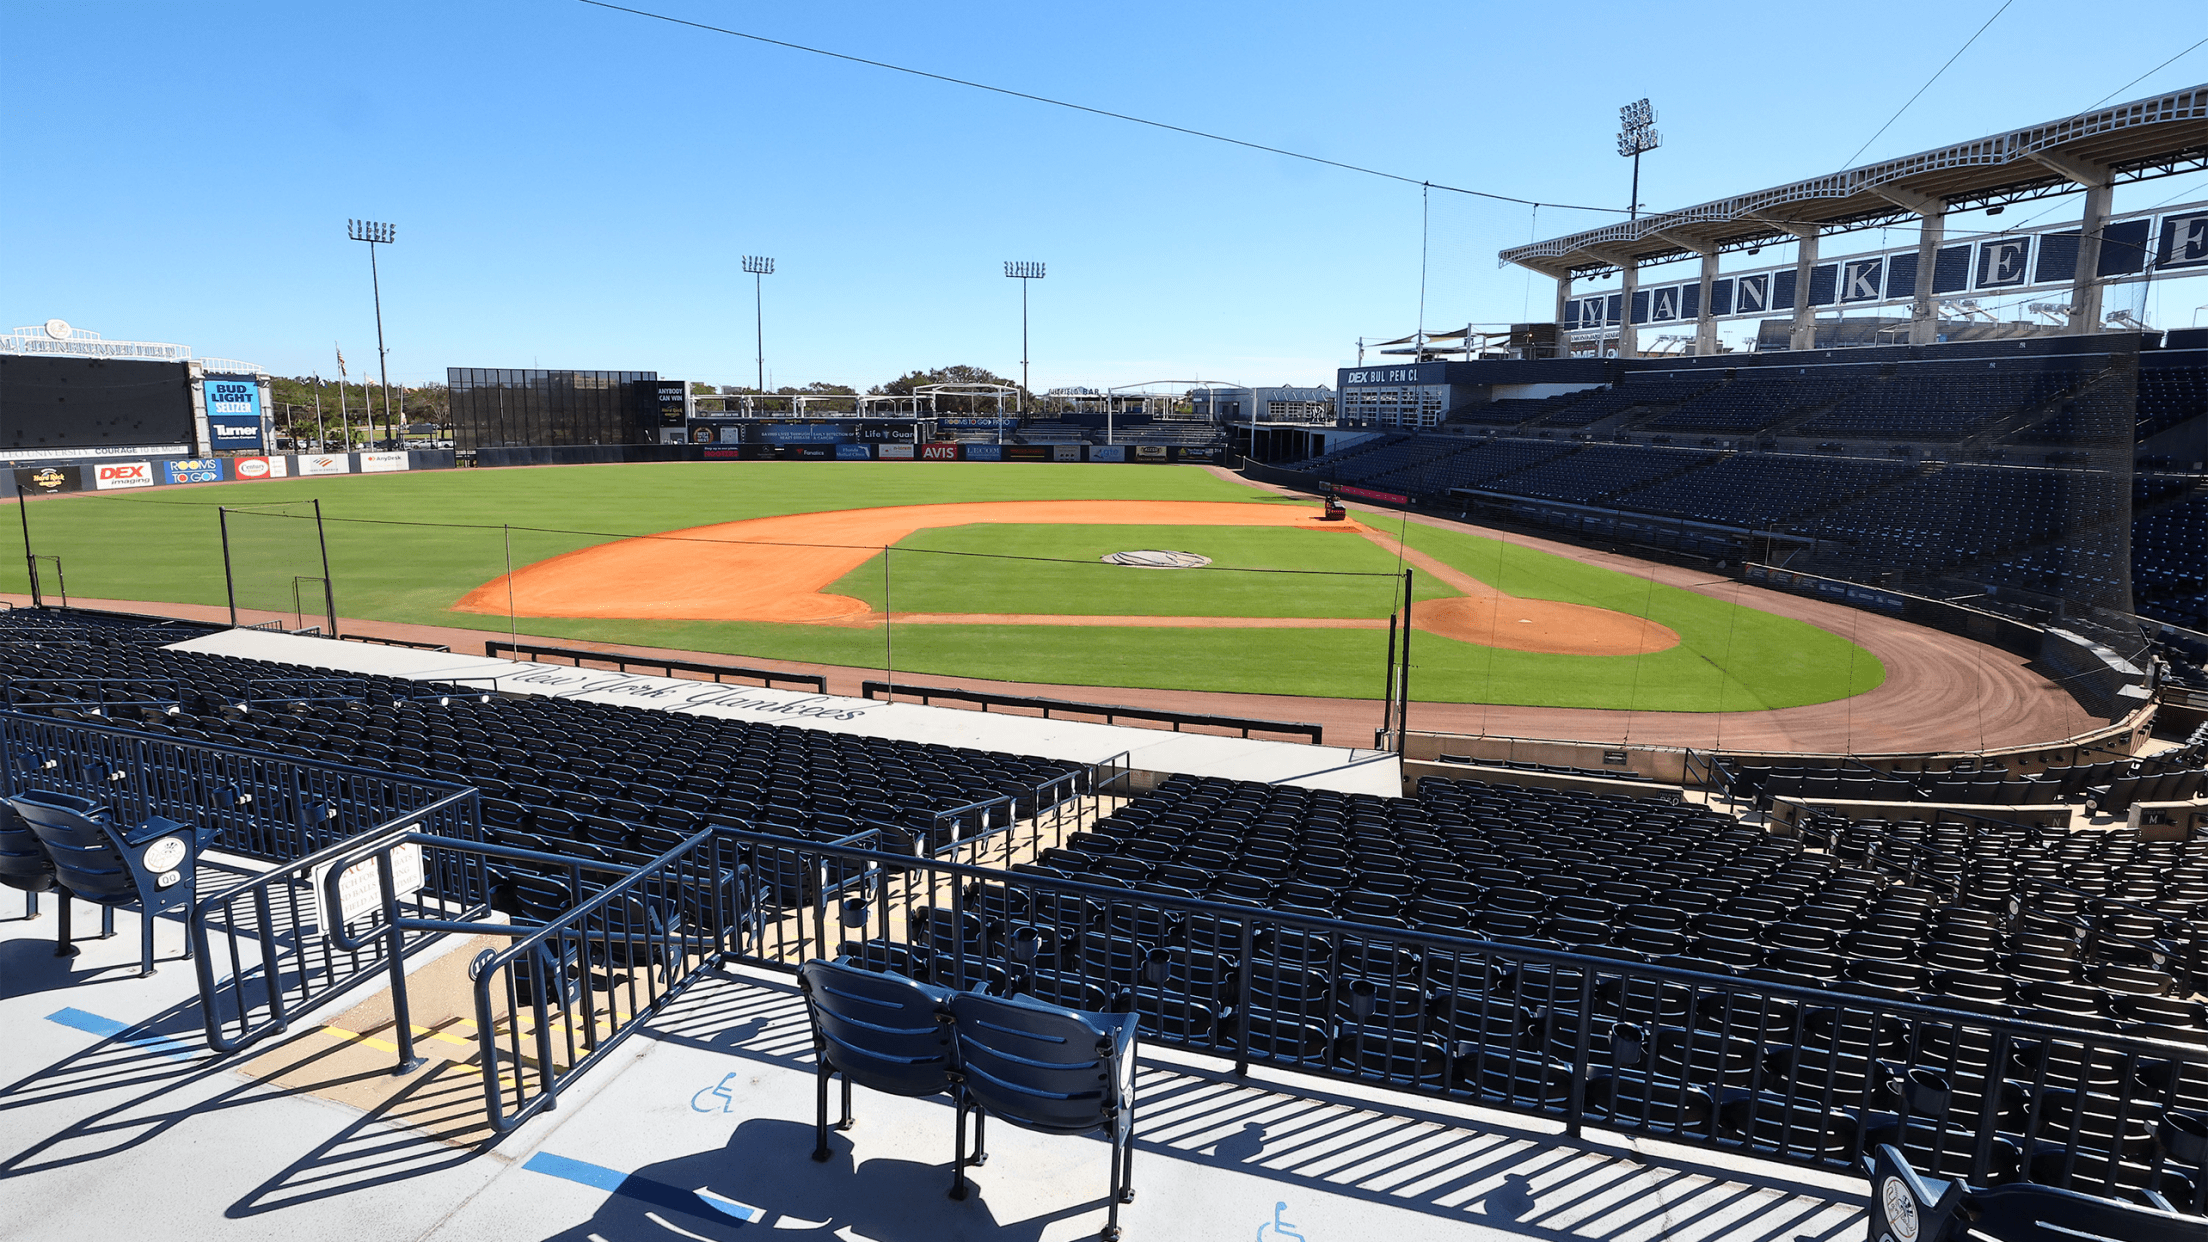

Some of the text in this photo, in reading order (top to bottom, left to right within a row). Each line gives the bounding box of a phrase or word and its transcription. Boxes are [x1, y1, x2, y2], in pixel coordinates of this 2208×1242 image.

[136, 345, 175, 357] FIELD
[1348, 371, 1369, 384] DEX
[216, 384, 247, 393] BUD
[211, 393, 253, 402] LIGHT
[215, 402, 252, 413] SELTZER
[213, 424, 258, 436] Turner
[864, 430, 881, 438] Life
[95, 446, 138, 455] COURAGE
[923, 447, 955, 458] AVIS
[170, 459, 216, 470] ROOMS
[100, 465, 144, 480] DEX
[172, 473, 188, 483] TO
[111, 477, 151, 485] imaging
[494, 663, 867, 721] New York Yankees
[2052, 818, 2061, 827] N
[2149, 815, 2158, 824] M
[359, 870, 375, 883] FOR
[394, 854, 413, 867] BATS
[162, 874, 176, 884] QQ
[345, 874, 418, 913] FIELD AT TIMES
[353, 882, 377, 896] BALLS
